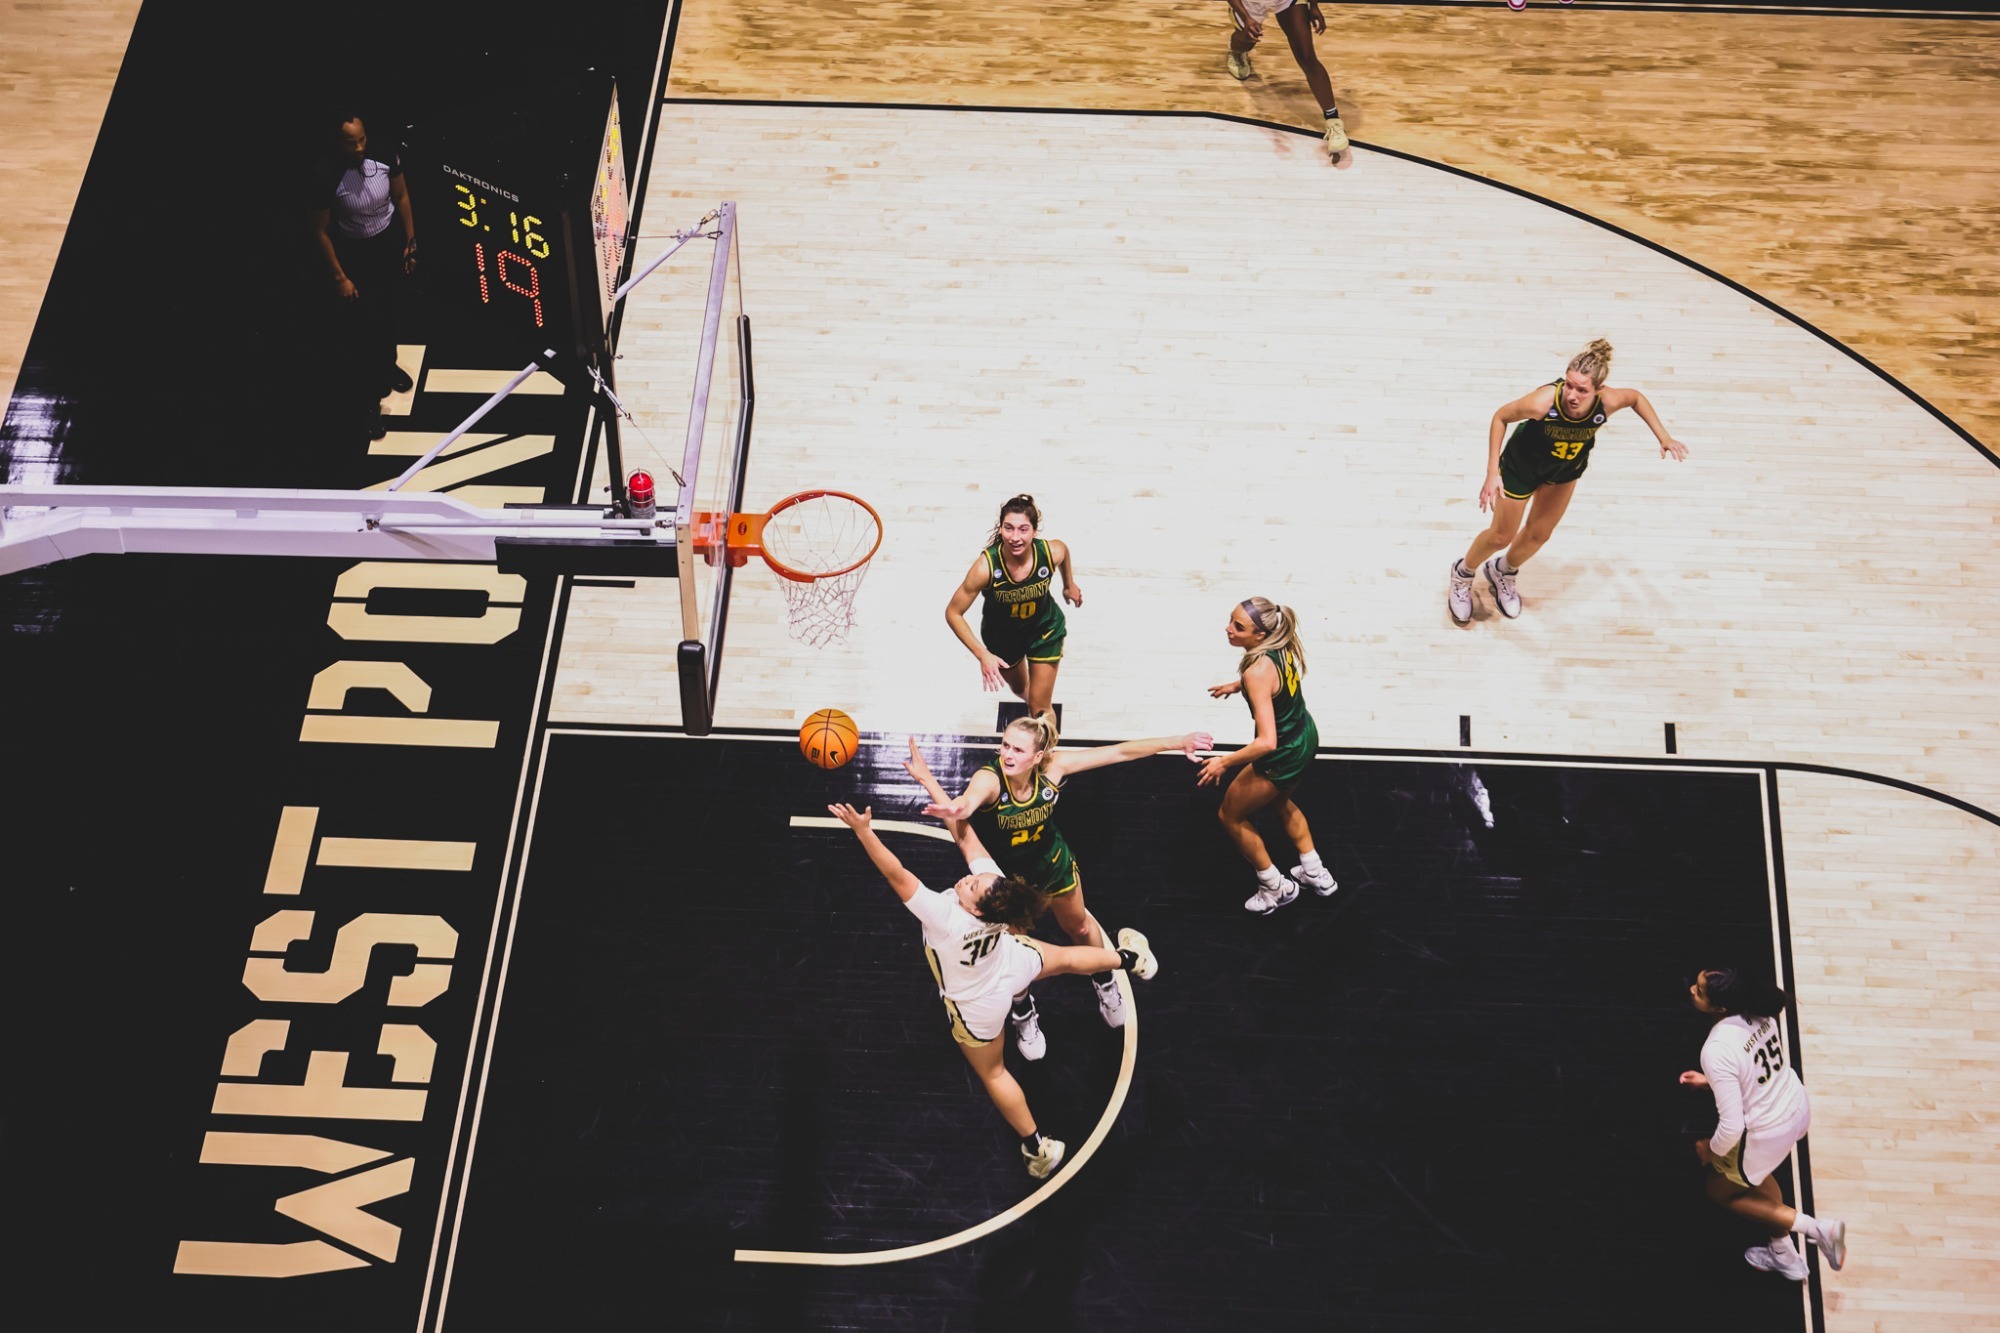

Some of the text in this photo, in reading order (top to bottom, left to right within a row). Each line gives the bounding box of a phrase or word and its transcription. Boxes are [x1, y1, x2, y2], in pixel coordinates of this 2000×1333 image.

[443, 164, 519, 203] DAKTRONICS
[475, 242, 544, 328] 19
[1550, 441, 1585, 460] 33
[995, 578, 1050, 602] VERMONT
[1010, 601, 1037, 620] 10
[174, 345, 564, 1278] WEST PONT
[959, 931, 1001, 966] 30
[963, 929, 984, 941] WEST
[1743, 1033, 1759, 1054] WEST
[1754, 1035, 1783, 1084] 35
